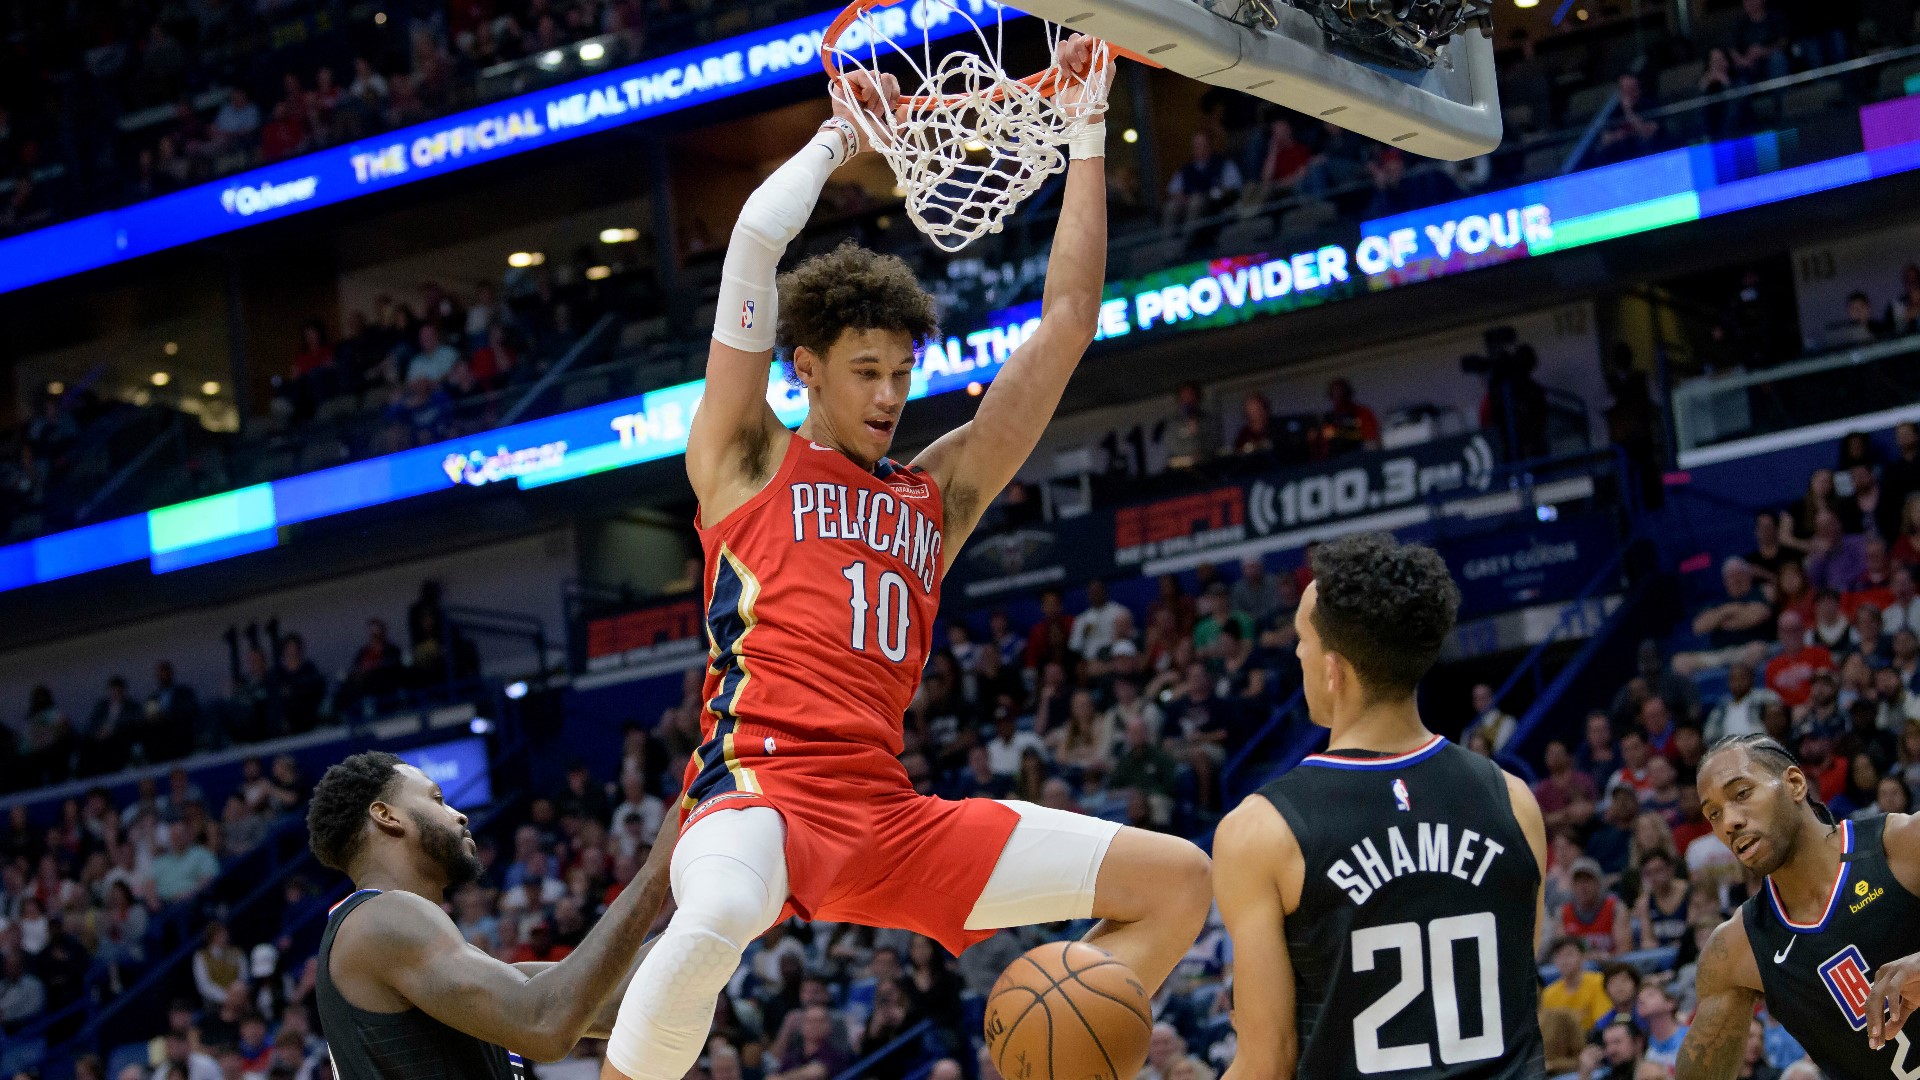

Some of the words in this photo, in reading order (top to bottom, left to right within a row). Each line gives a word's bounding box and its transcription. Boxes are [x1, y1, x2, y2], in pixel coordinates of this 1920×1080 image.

[350, 144, 407, 184] THE
[411, 107, 544, 167] OFFICIAL
[546, 51, 745, 130] HEALTHCARE
[747, 7, 906, 76] PROVDER
[611, 400, 684, 449] THE
[1136, 245, 1349, 328] PROVIDER
[1356, 227, 1418, 275] OF
[1425, 203, 1552, 260] YOUR
[790, 482, 942, 595] PELICANS
[1279, 457, 1417, 524] 100.3
[842, 560, 910, 663] 10
[1327, 822, 1505, 905] SHAMET
[1849, 887, 1884, 914] bumble
[1351, 911, 1505, 1074] 20
